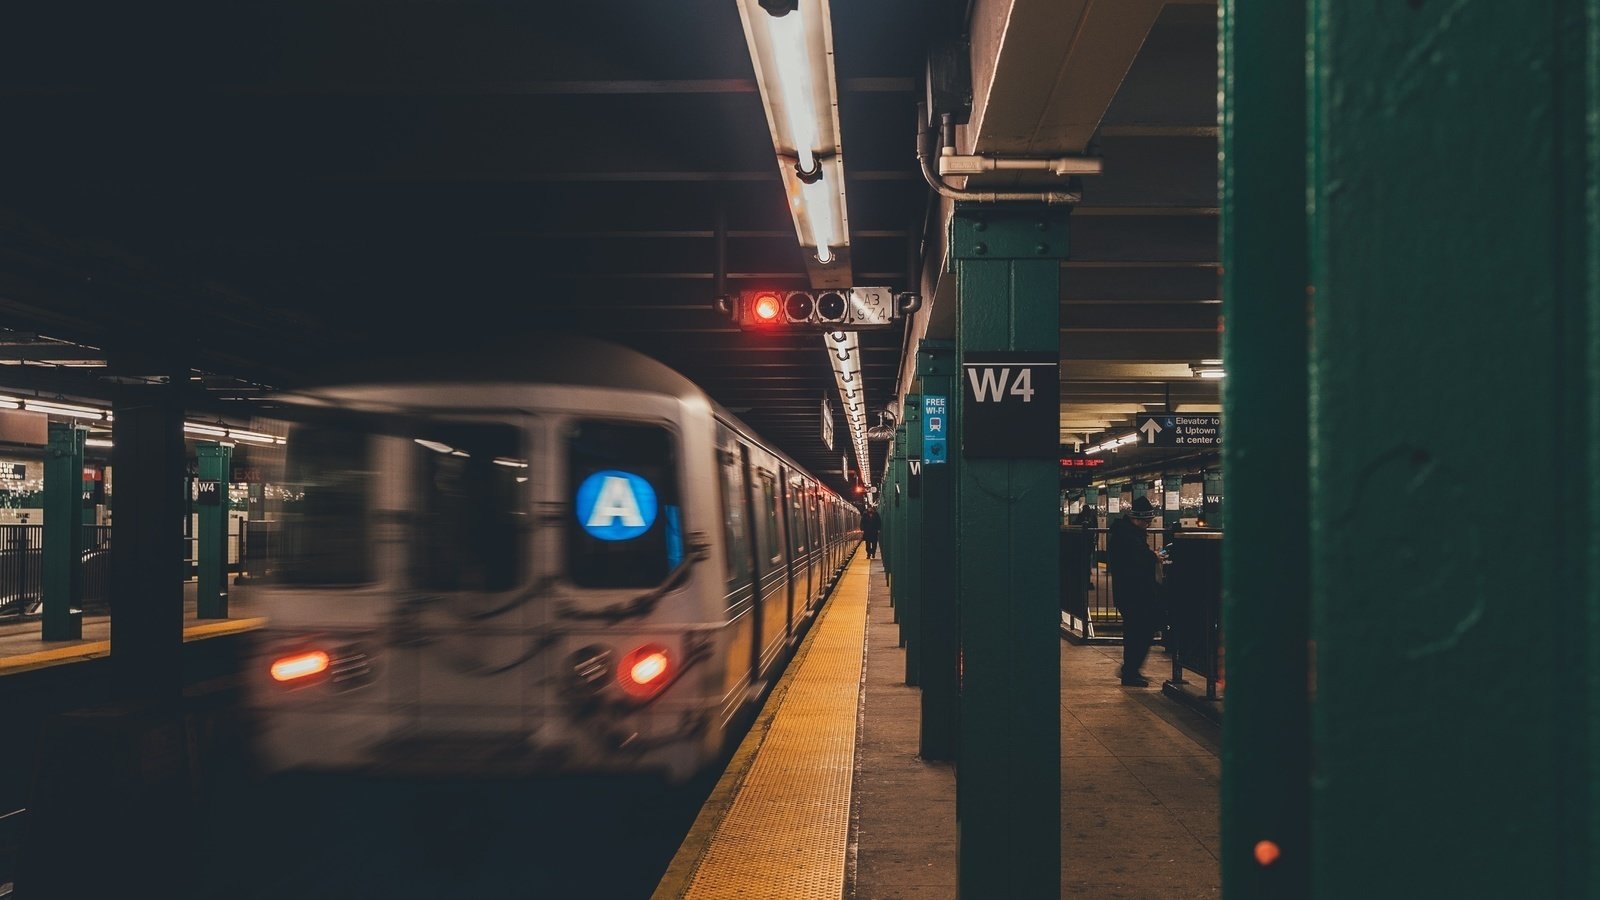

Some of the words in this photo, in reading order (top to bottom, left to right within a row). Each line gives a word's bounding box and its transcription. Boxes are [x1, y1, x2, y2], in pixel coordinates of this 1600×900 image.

[864, 293, 880, 306] A3
[967, 368, 1035, 403] W4
[925, 398, 945, 406] FREE
[925, 406, 945, 415] WI-FI
[1175, 417, 1208, 425] Elevator
[1211, 417, 1220, 425] to
[1175, 426, 1183, 434] &
[1185, 426, 1216, 436] Uptown
[1175, 436, 1185, 444] at
[1187, 436, 1214, 444] center
[909, 461, 921, 476] W
[198, 482, 215, 492] W4
[586, 476, 646, 527] A
[1206, 495, 1219, 503] W4
